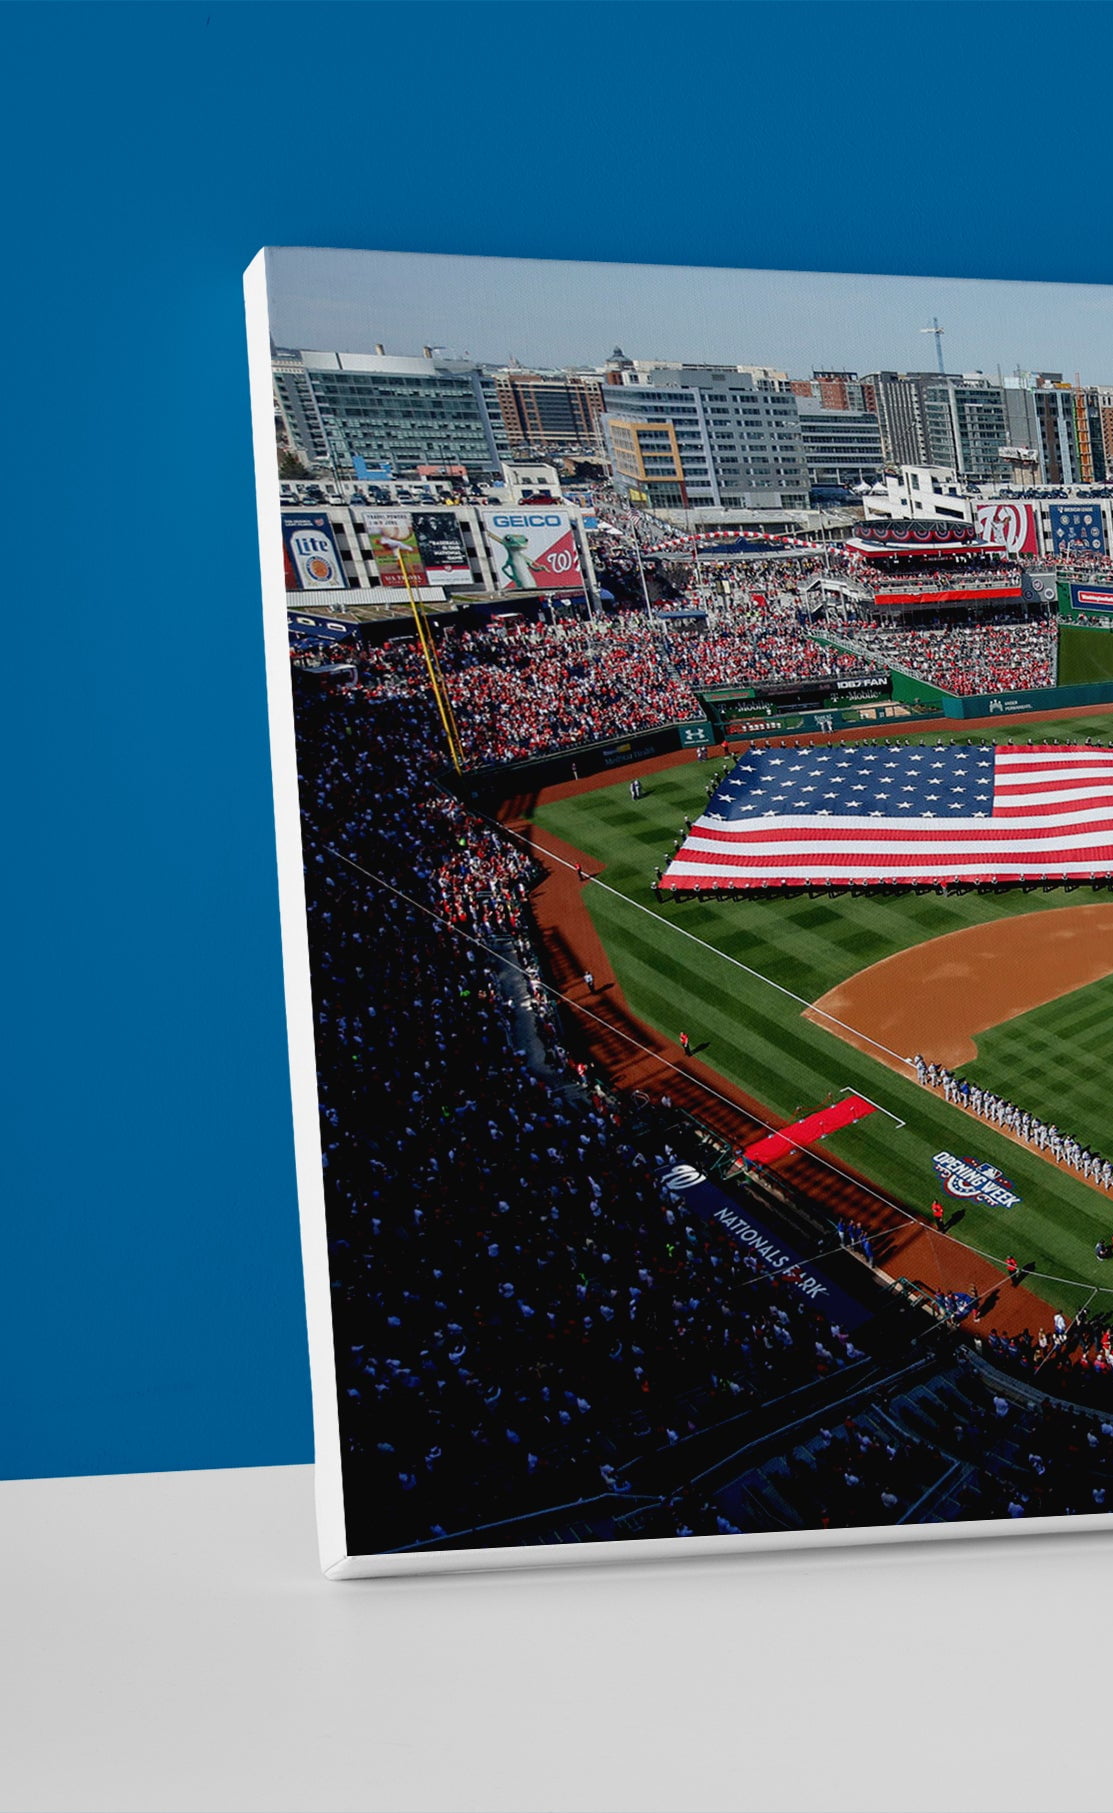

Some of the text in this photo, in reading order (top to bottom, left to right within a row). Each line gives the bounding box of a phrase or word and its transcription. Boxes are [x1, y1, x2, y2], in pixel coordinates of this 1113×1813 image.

[492, 515, 562, 528] GEICO
[296, 538, 328, 556] Lite
[863, 677, 888, 687] FAN
[933, 1152, 1021, 1208] OPENING WEEK
[714, 1207, 790, 1268] NATIONALS
